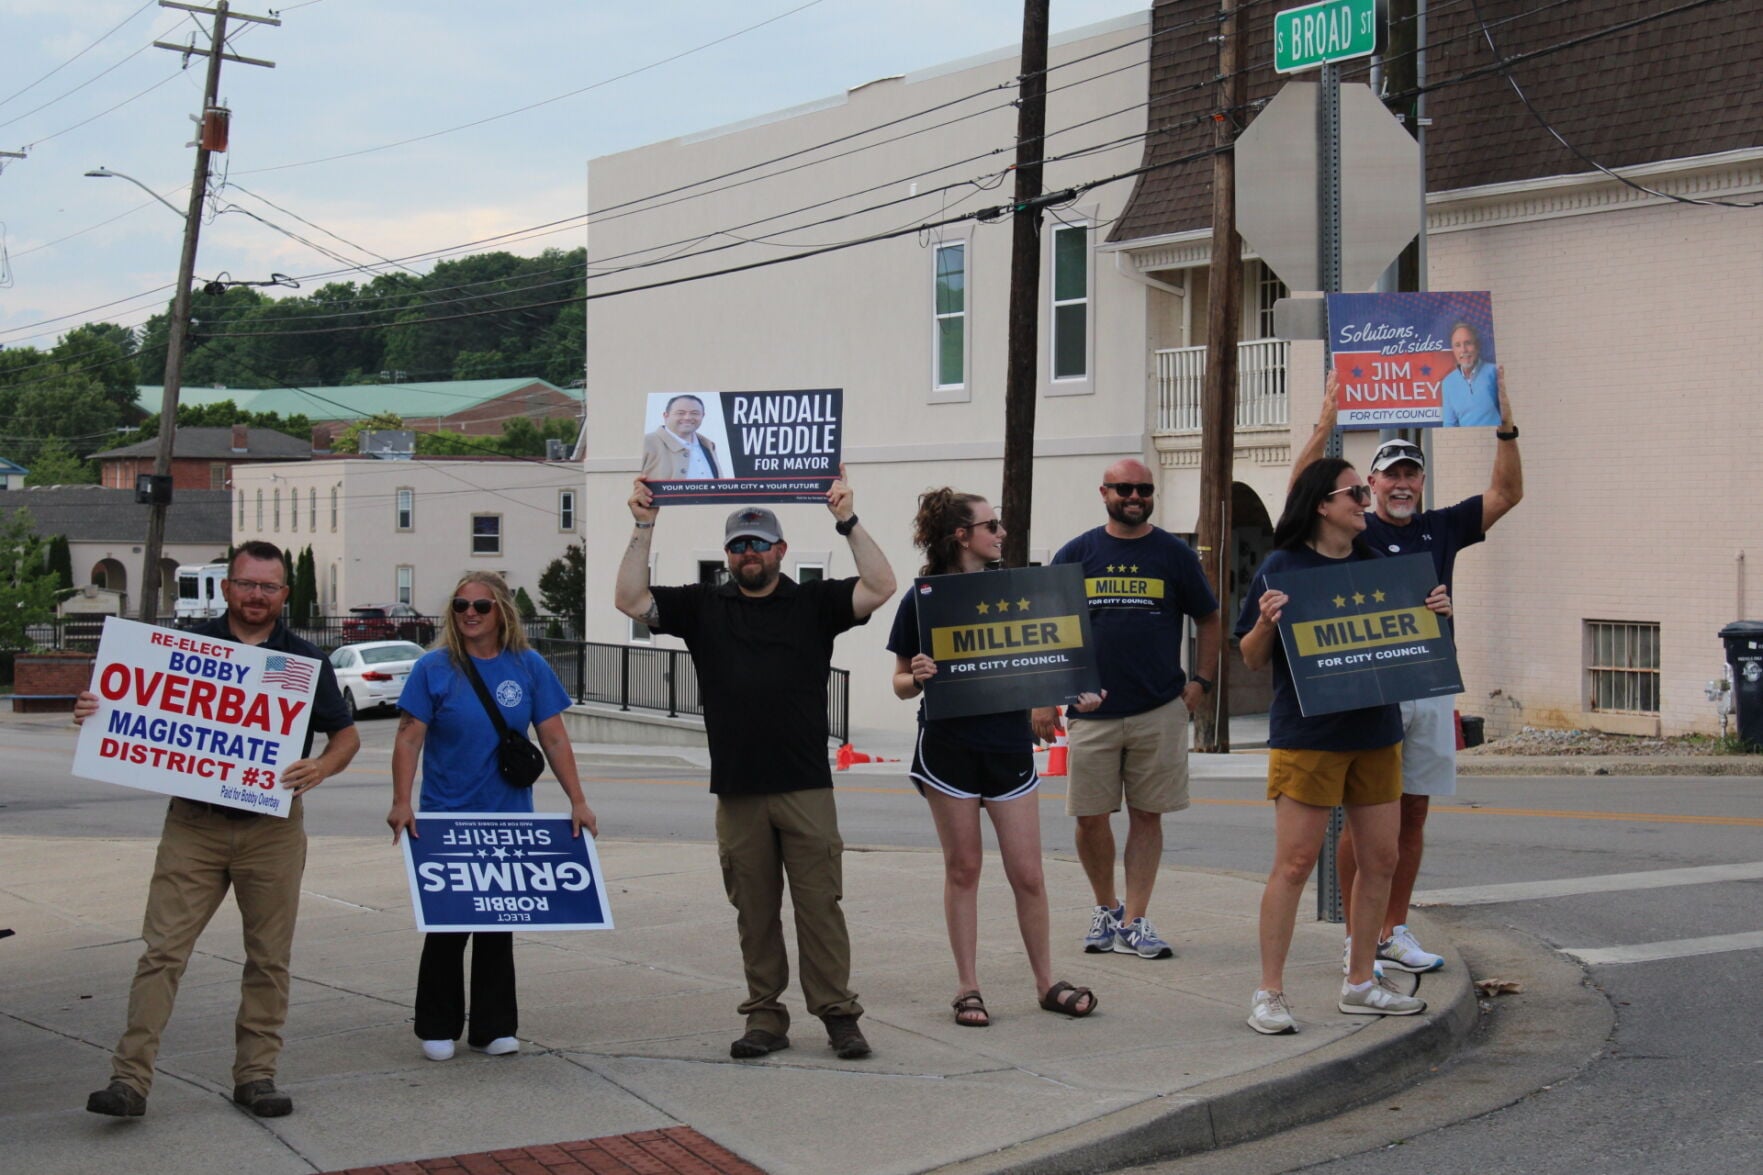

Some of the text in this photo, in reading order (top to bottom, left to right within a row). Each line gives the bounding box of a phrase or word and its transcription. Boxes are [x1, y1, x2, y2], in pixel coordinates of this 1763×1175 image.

[1278, 6, 1372, 61] S BROAD ST
[1339, 322, 1419, 344] Solutions,
[1407, 334, 1444, 353] sides
[1371, 361, 1411, 381] JIM
[1345, 381, 1441, 402] NUNLEY
[733, 394, 836, 425] RANDALL
[1350, 408, 1441, 421] FOR CITY COUNCIL
[741, 424, 836, 456] WEDDLE
[754, 456, 829, 471] FOR MAYOR
[685, 483, 709, 491] VOICE
[766, 482, 788, 490] YOUR
[1095, 579, 1148, 595] MILLER
[1121, 598, 1155, 606] COUNCIL
[952, 621, 1061, 654] MILLER
[1313, 612, 1420, 648] MILLER
[150, 632, 235, 659] RE-ELECT
[1317, 644, 1430, 668] FOR CITY COUNCIL
[168, 651, 250, 685] BOBBY
[950, 654, 1069, 673] FOR CITY COUNCIL
[99, 662, 307, 736] OVERBAY
[108, 709, 280, 766] MAGISTRATE
[99, 737, 276, 790] DISTRICT #3
[220, 784, 280, 811] Paid for Bobby Overbay
[443, 829, 552, 846] SHERIFF
[418, 861, 591, 893] GRIMES
[473, 896, 550, 912] ROBBIE
[497, 913, 531, 922] ELECT
[1127, 931, 1140, 946] N
